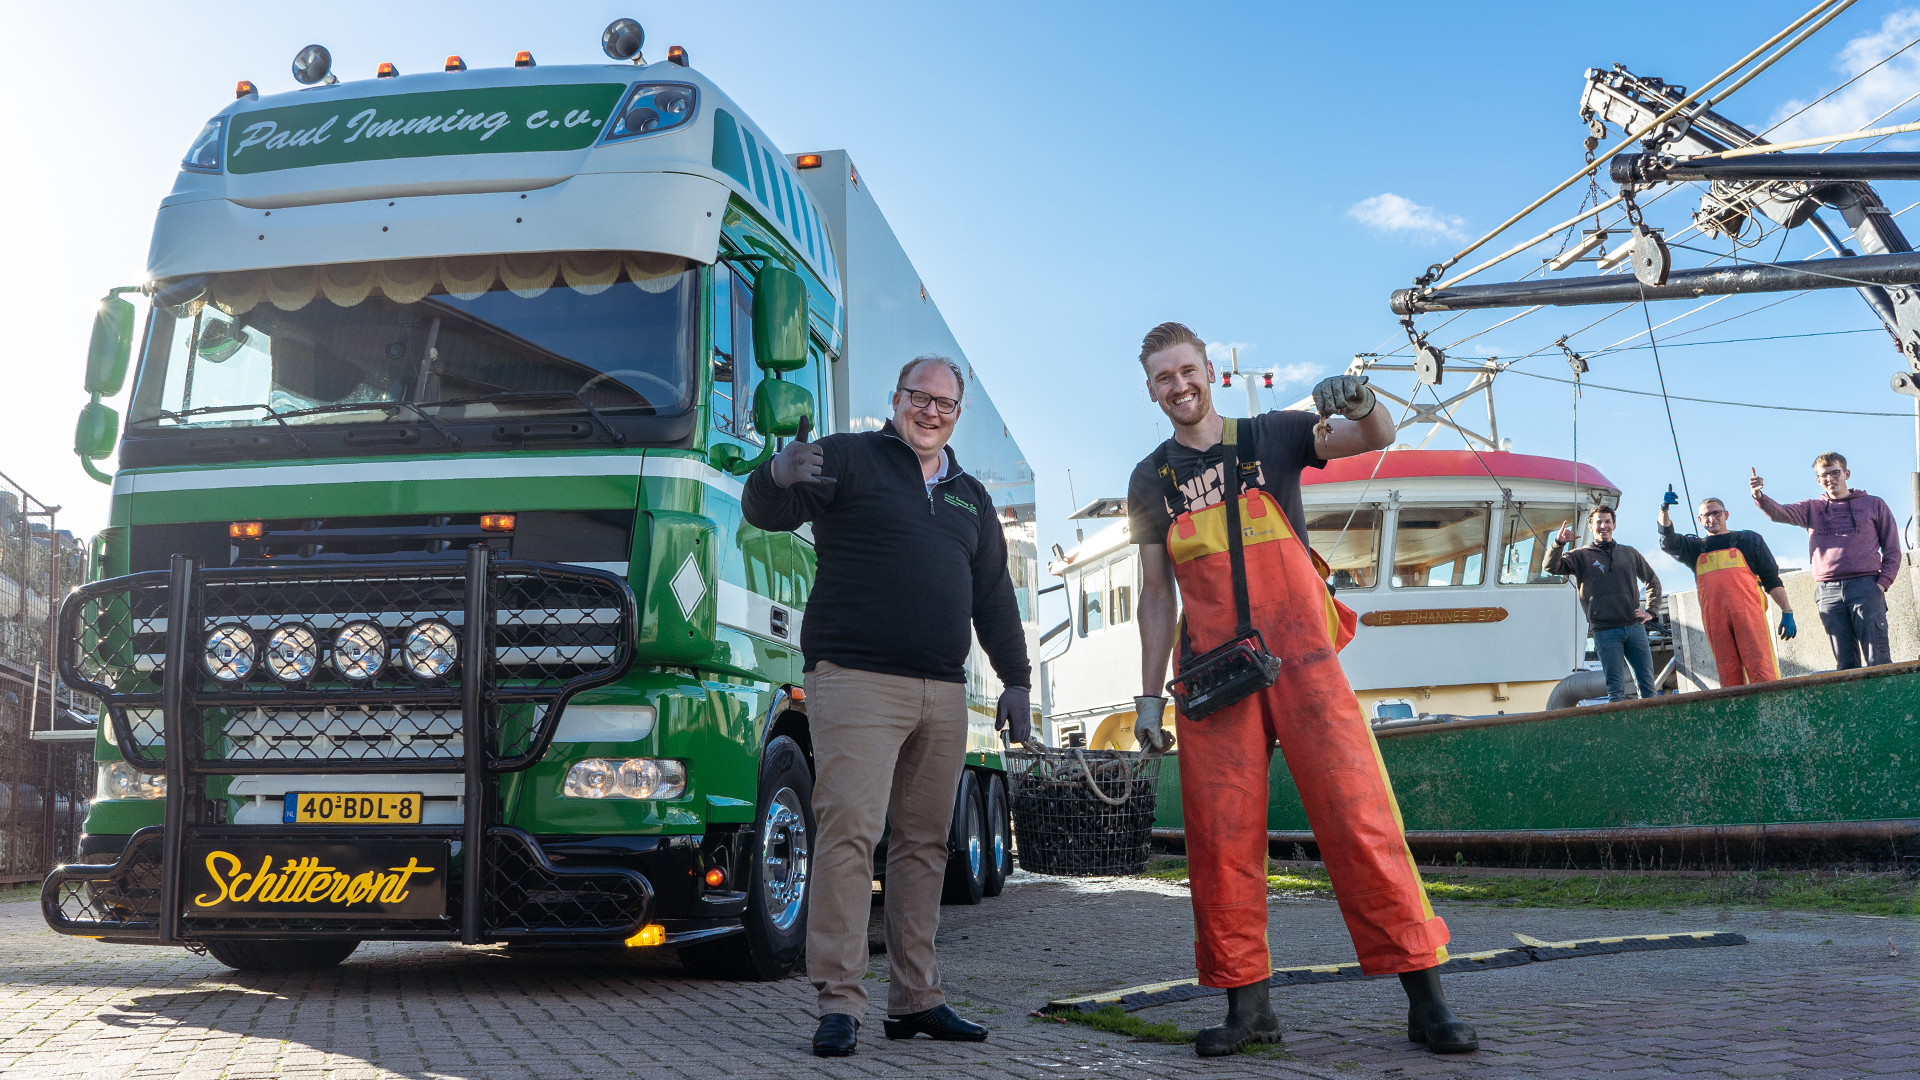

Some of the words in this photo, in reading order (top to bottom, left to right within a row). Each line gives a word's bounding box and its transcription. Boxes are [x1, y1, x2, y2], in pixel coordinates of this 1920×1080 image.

[232, 114, 339, 157] Paul
[343, 108, 511, 144] Imming
[1401, 610, 1470, 624] JOHANNES
